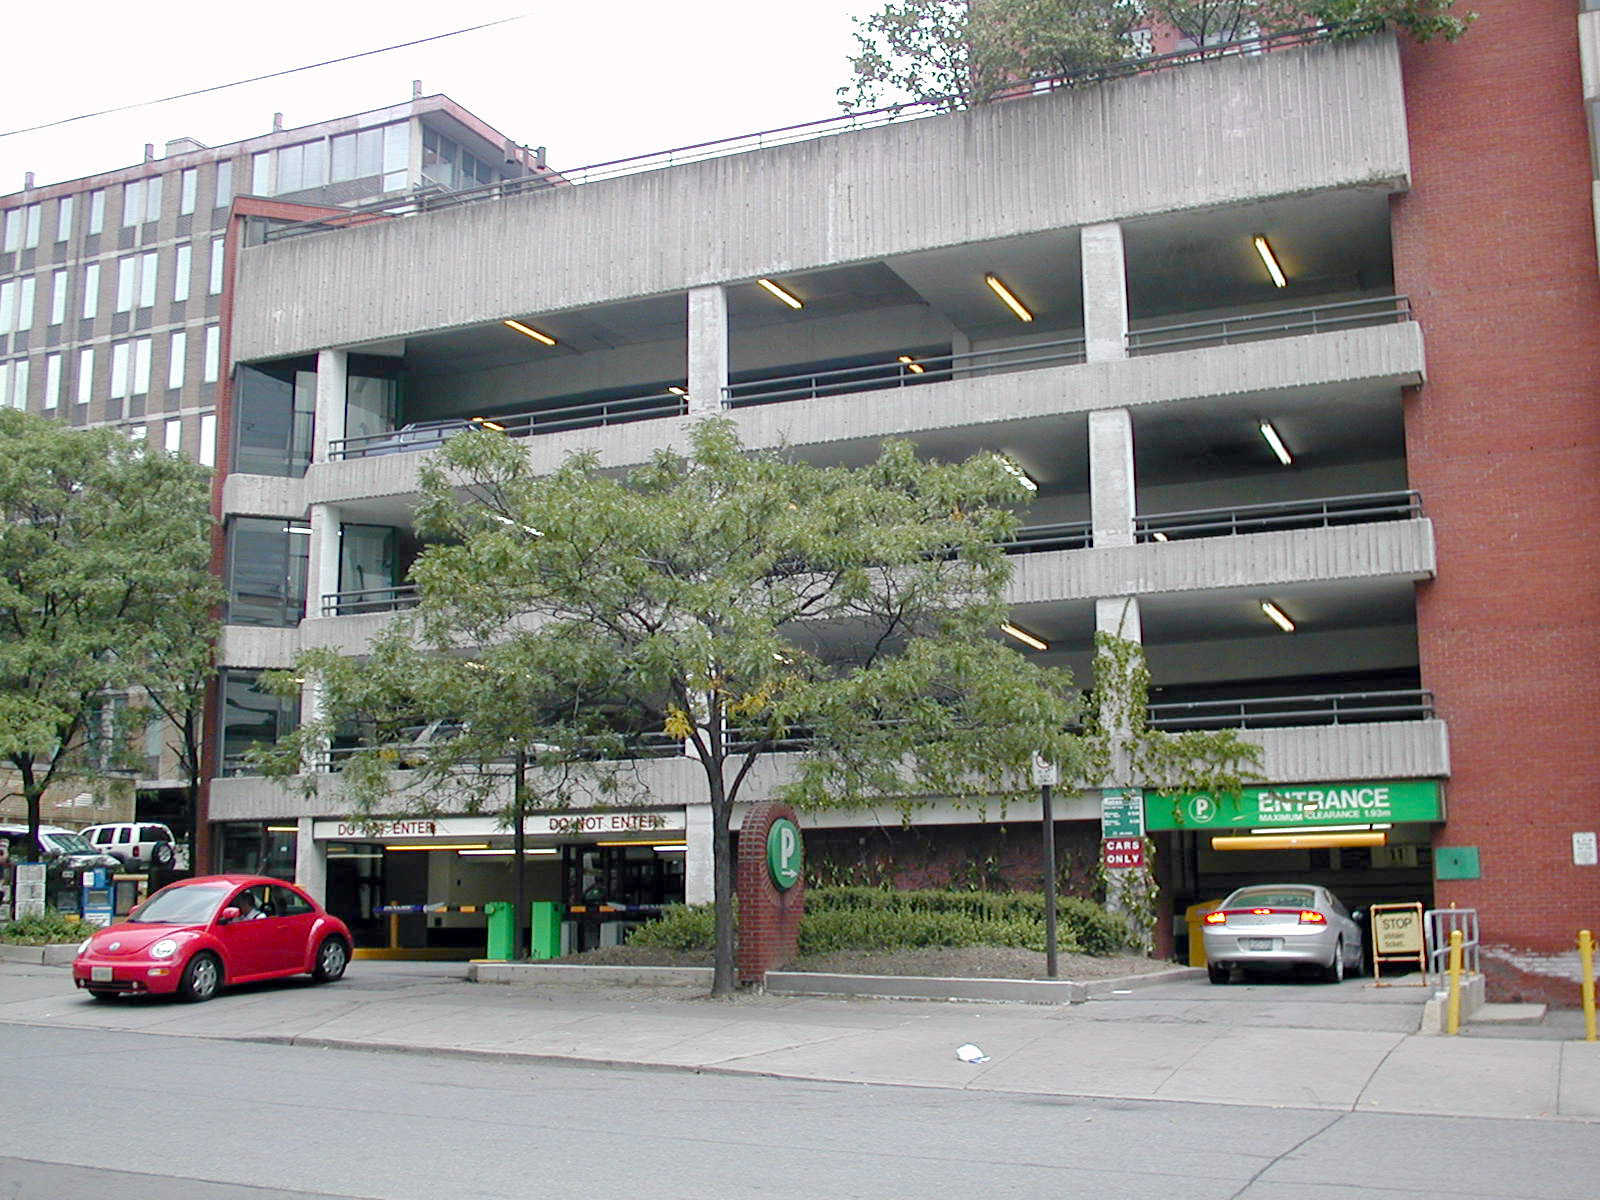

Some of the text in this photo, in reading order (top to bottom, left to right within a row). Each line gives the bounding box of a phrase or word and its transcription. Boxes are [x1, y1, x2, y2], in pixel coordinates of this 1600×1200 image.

[1195, 799, 1209, 815] P
[1258, 788, 1390, 812] ENTRANCE
[1258, 811, 1303, 822] MAXIMUM
[1304, 808, 1360, 820] CLEARANCE
[393, 821, 435, 835] ENTER
[548, 815, 657, 831] DO NOT ENTER
[781, 828, 795, 868] P
[1106, 840, 1140, 851] CARS
[1106, 855, 1140, 864] ONLY
[1382, 917, 1412, 929] STOP
